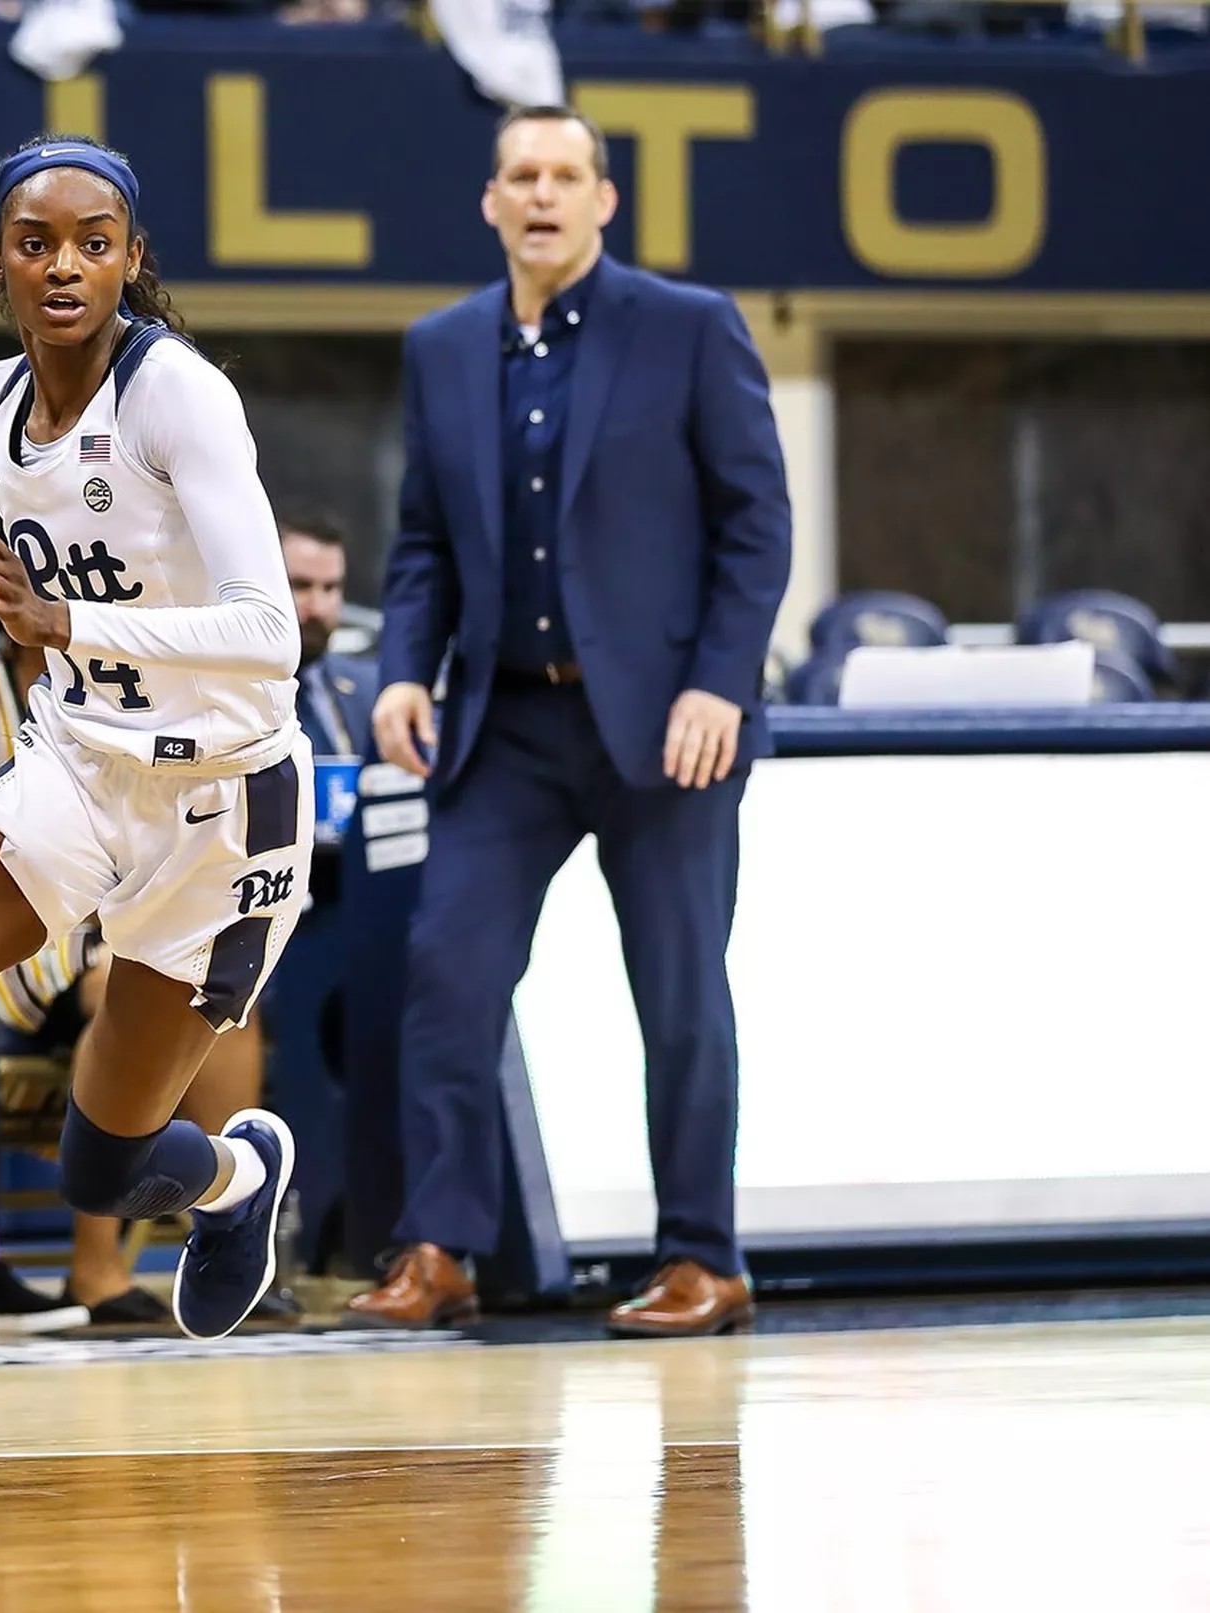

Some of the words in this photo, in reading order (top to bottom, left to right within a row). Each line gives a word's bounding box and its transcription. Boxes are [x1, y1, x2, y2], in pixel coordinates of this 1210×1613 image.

[570, 80, 1049, 279] TO
[8, 517, 144, 605] Pitt
[62, 653, 153, 711] 14
[163, 742, 186, 757] 42
[231, 865, 294, 915] Pitt
